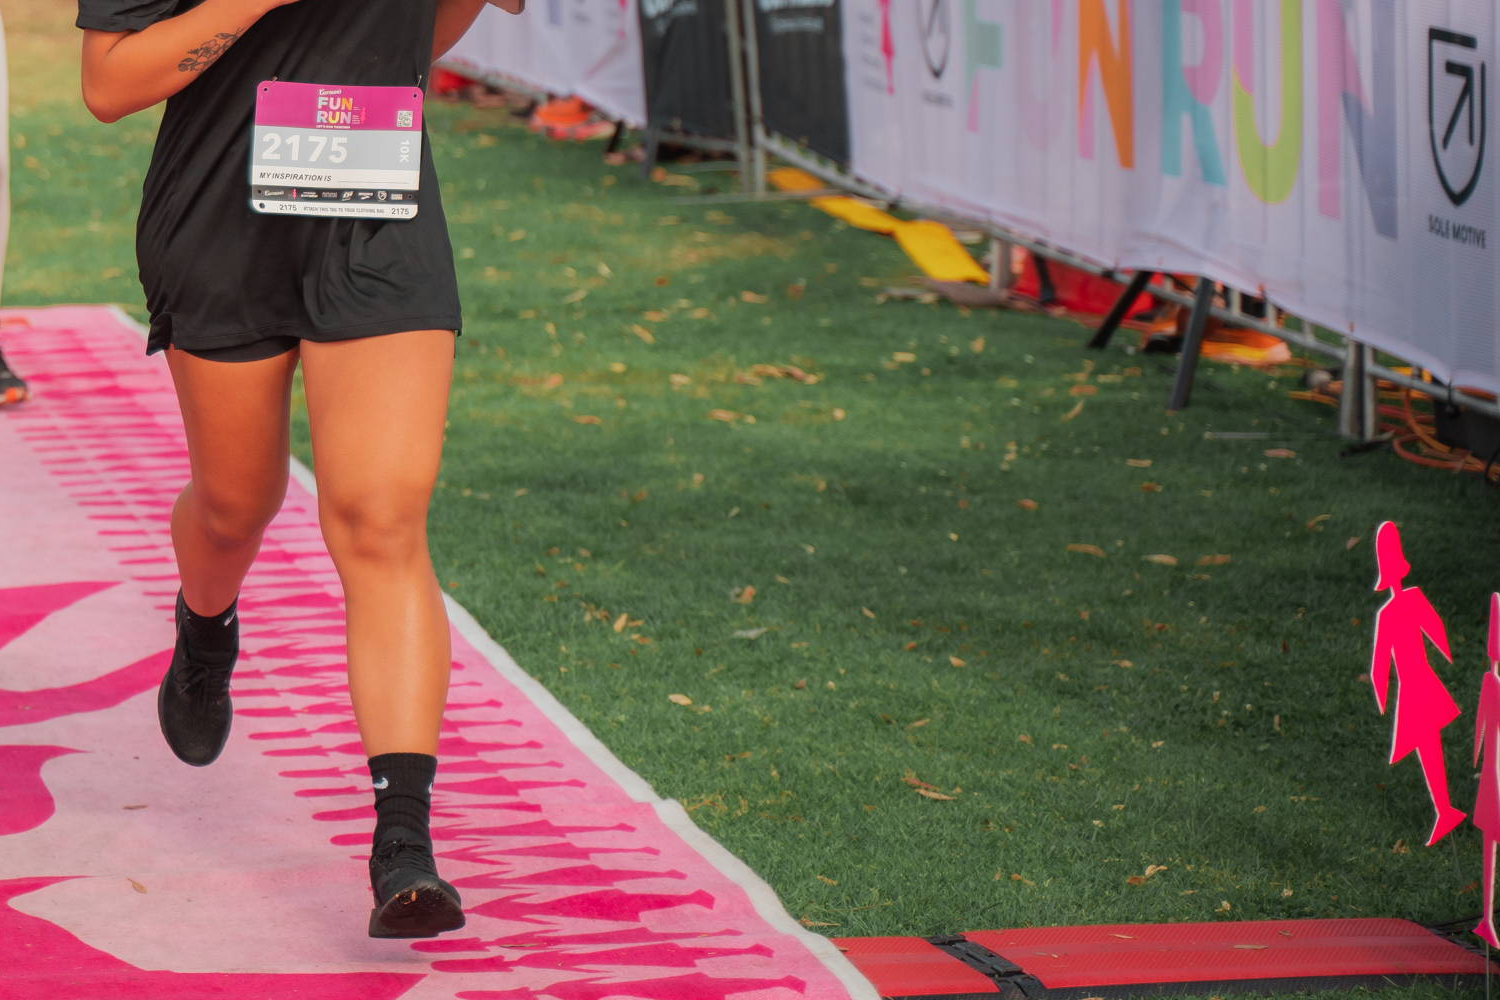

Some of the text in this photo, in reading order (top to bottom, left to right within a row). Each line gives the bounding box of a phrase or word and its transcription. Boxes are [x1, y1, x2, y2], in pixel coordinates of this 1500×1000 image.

[317, 96, 353, 111] FUN
[316, 110, 352, 124] RUN
[261, 132, 348, 164] 2175
[399, 139, 410, 163] 10K
[272, 172, 323, 181] INSPIRATION
[391, 207, 410, 215] 2175
[1427, 213, 1486, 250] SOLE MOTIVE
